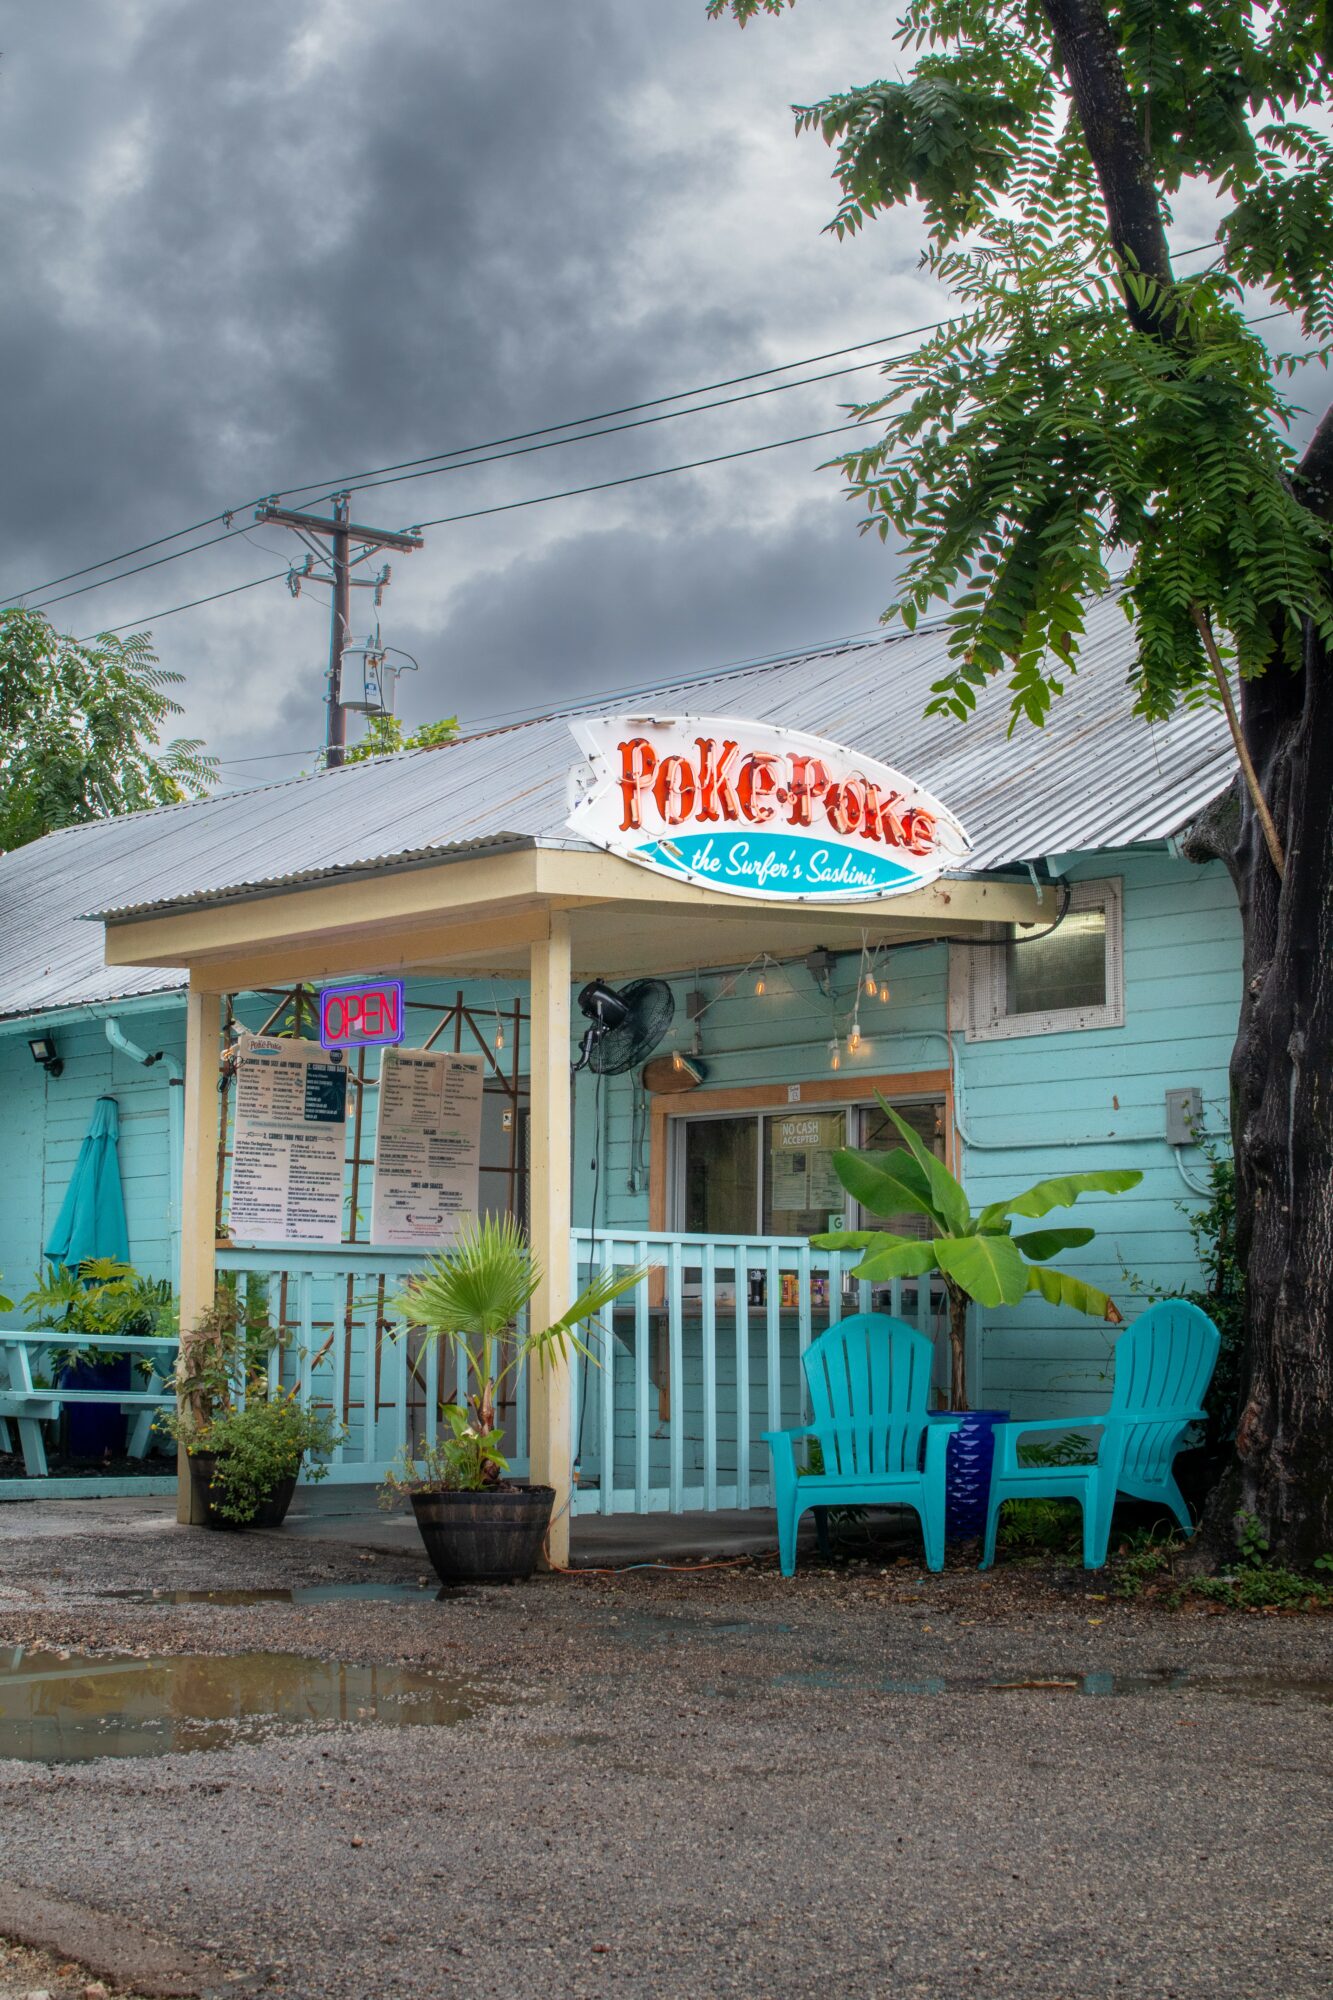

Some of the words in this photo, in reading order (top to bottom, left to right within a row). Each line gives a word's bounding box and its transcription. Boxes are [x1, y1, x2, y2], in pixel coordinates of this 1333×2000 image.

[691, 839, 722, 872] the
[725, 841, 802, 886] Surfer's
[805, 849, 876, 886] Sashimi
[324, 991, 398, 1040] OPEN
[782, 1123, 796, 1136] NO
[796, 1120, 819, 1134] CASH
[782, 1134, 819, 1145] ACCEPTED
